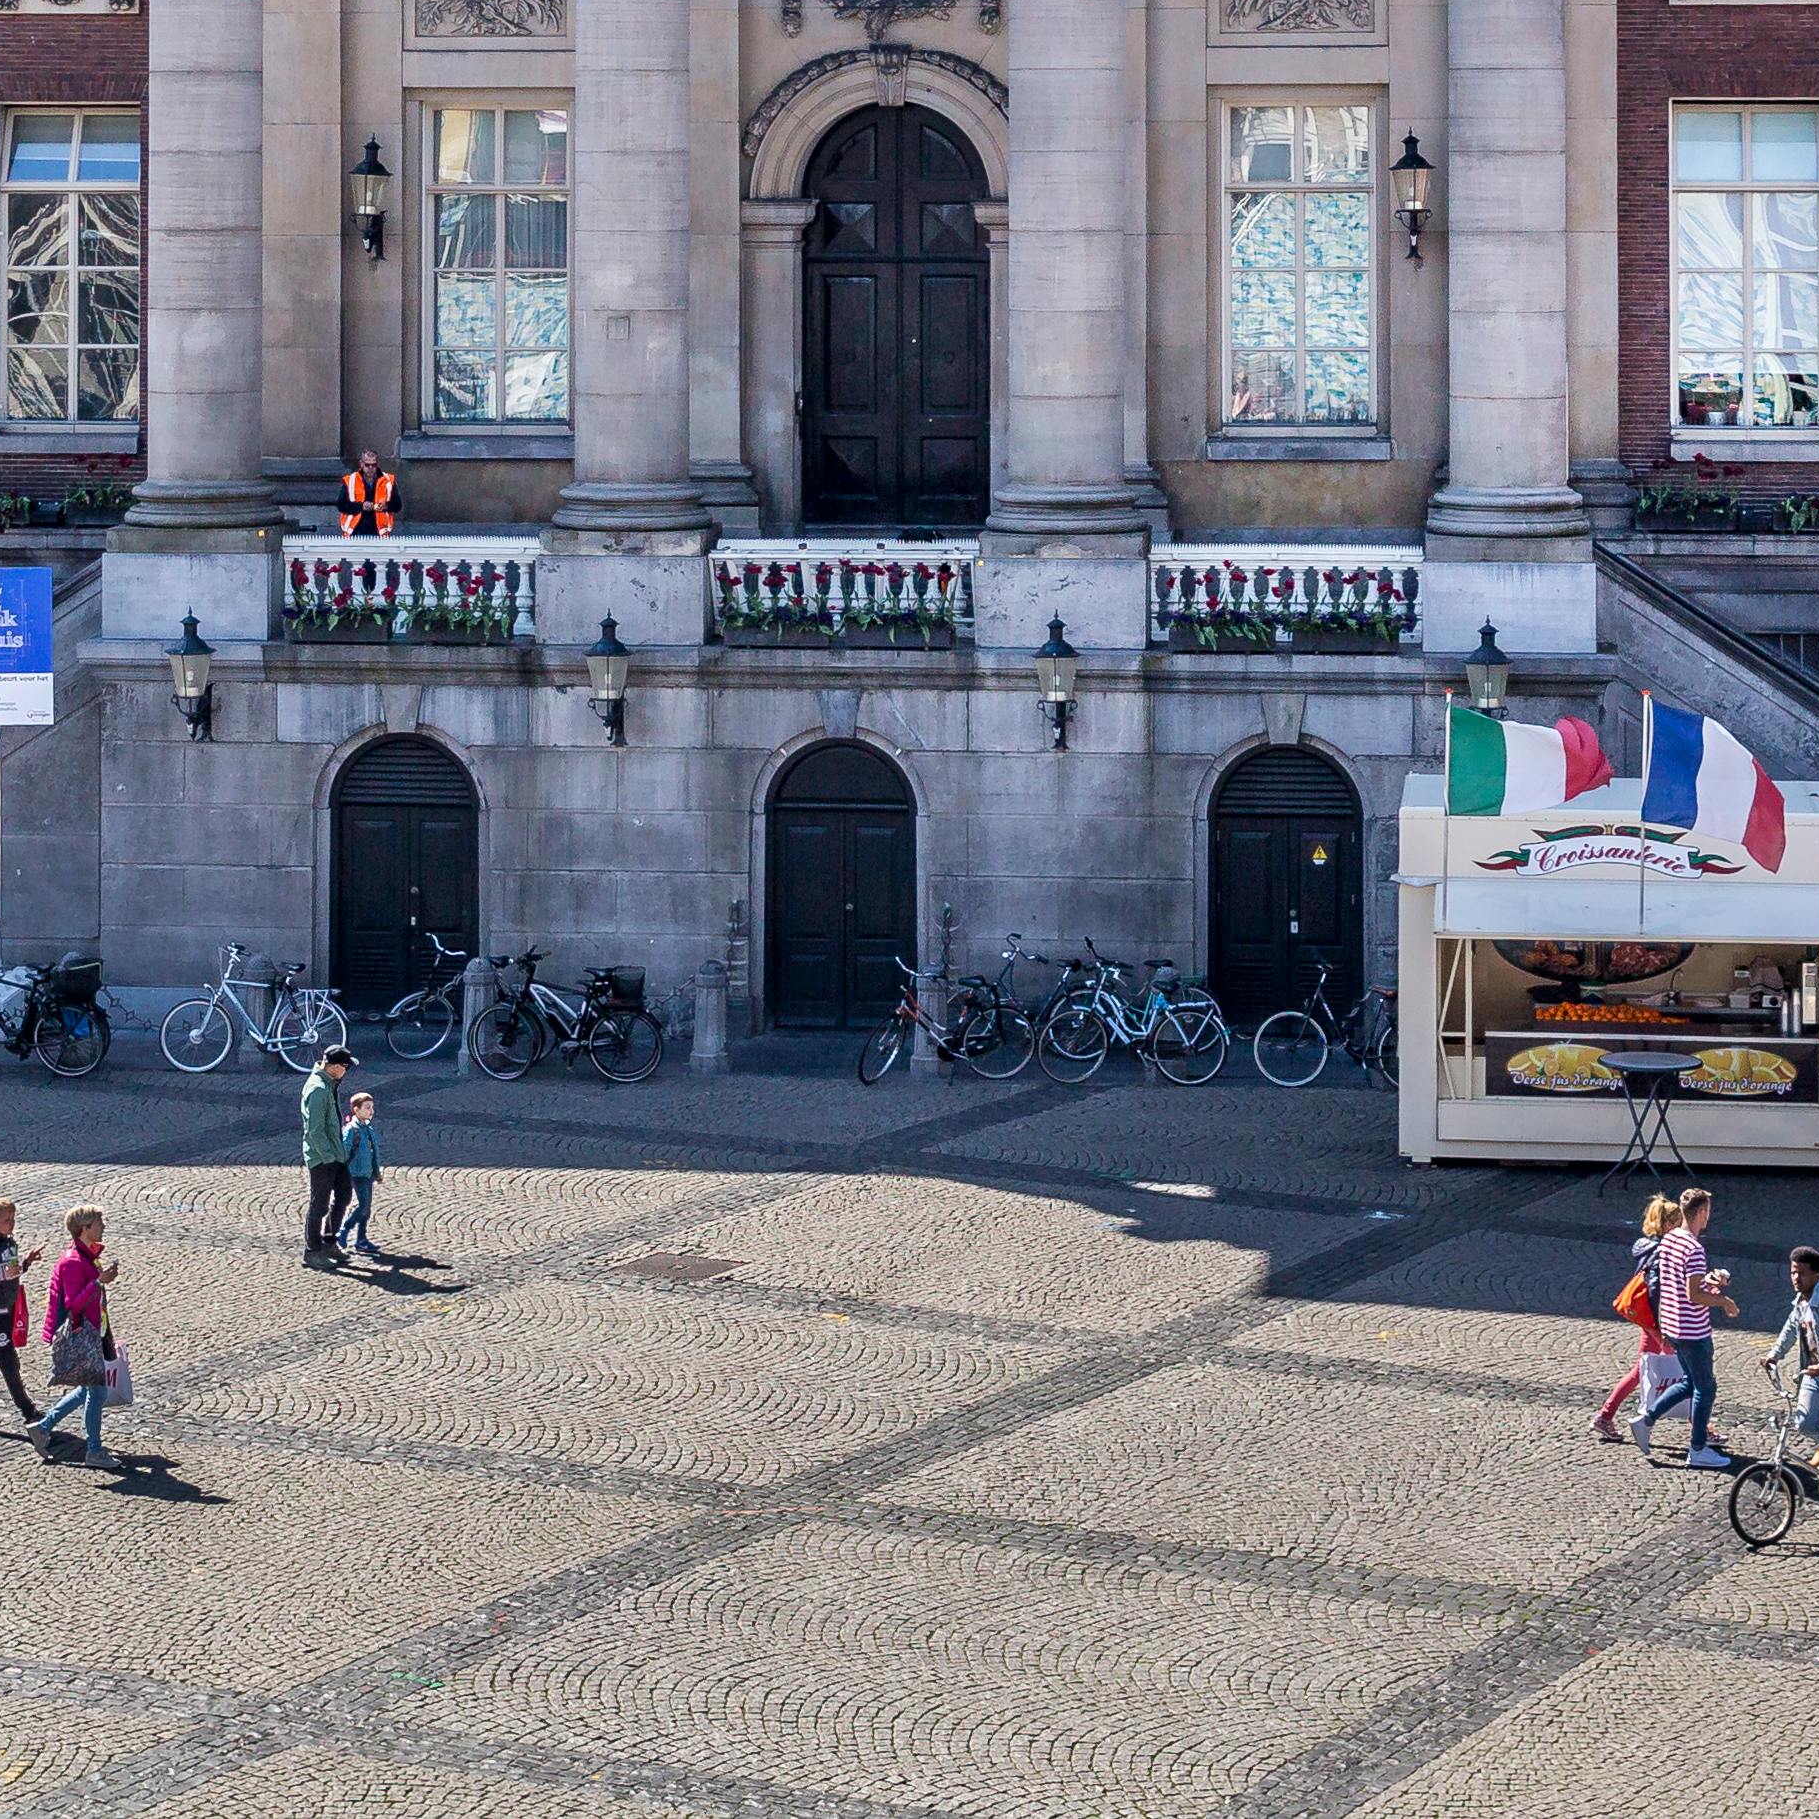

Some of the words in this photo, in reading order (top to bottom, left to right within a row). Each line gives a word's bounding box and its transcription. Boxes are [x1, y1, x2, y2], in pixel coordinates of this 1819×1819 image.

[1534, 843, 1688, 874] Croissanterie
[1509, 1070, 1546, 1086] Verse
[1549, 1073, 1571, 1089] jus
[1678, 1074, 1715, 1089] Verse
[1718, 1076, 1740, 1094] jus
[1741, 1077, 1793, 1095] d'orange
